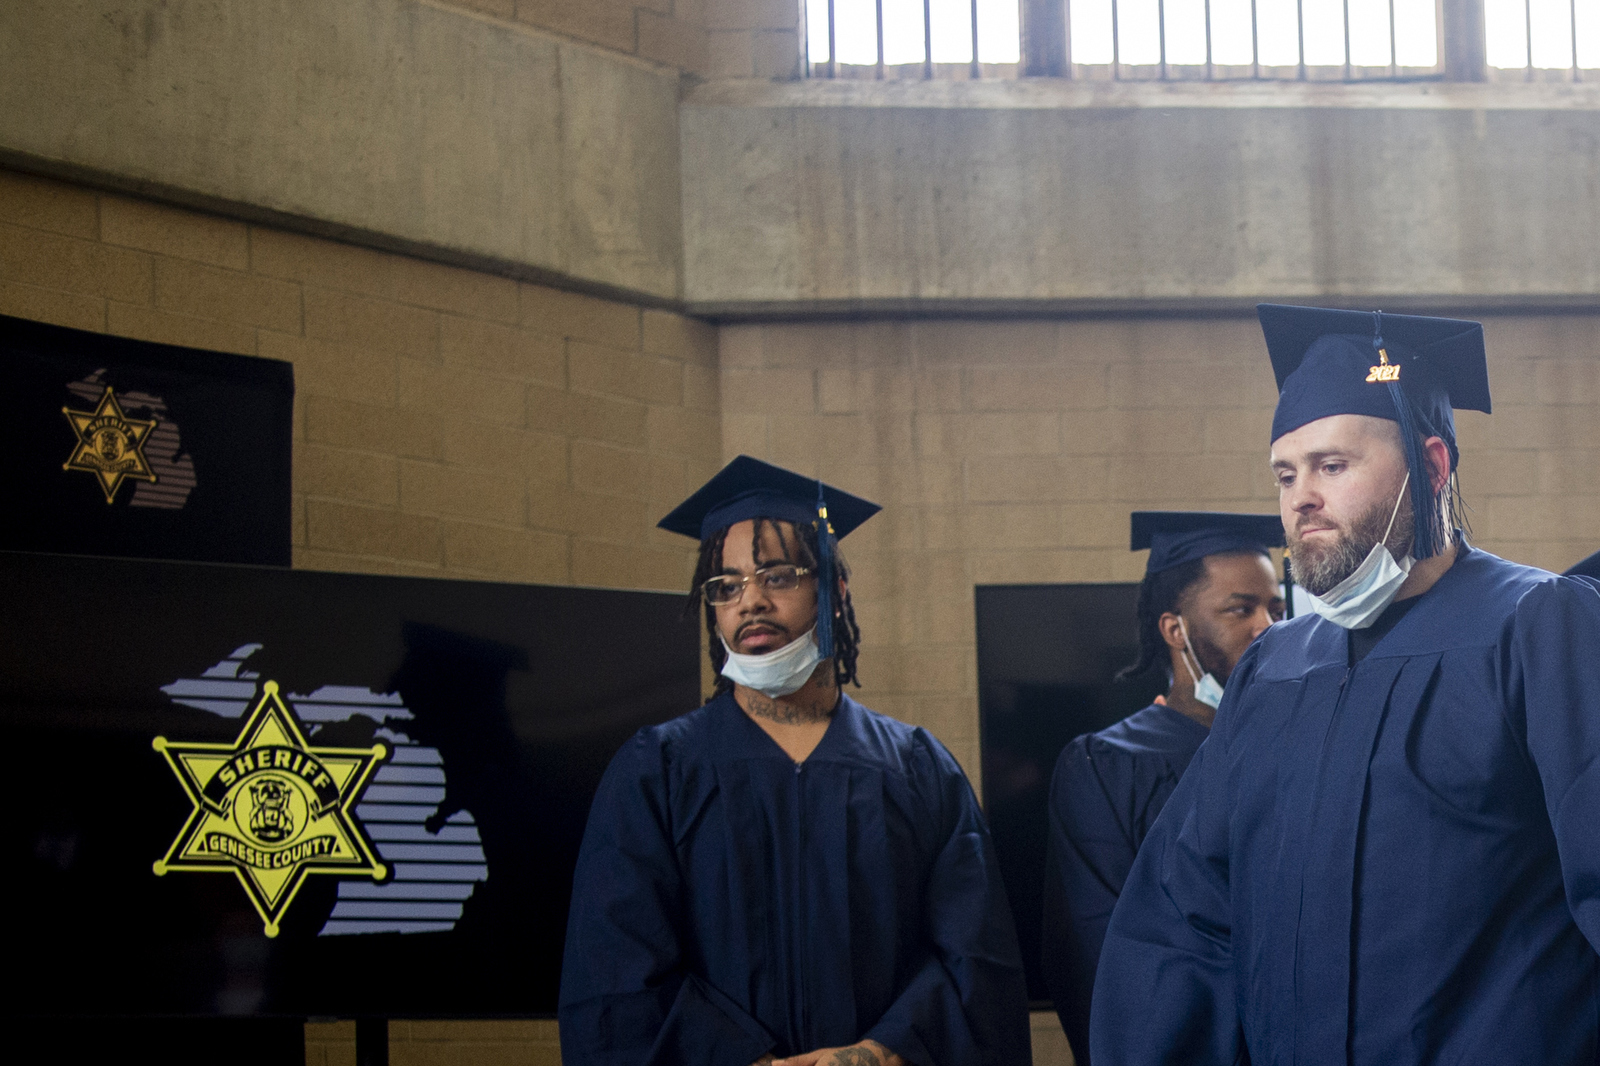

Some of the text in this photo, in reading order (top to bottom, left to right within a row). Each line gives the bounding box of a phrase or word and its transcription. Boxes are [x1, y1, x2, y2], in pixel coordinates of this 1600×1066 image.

[1365, 364, 1401, 382] 2021
[218, 749, 331, 789] SHERIFF
[209, 834, 331, 868] GENESEE COUNTY
